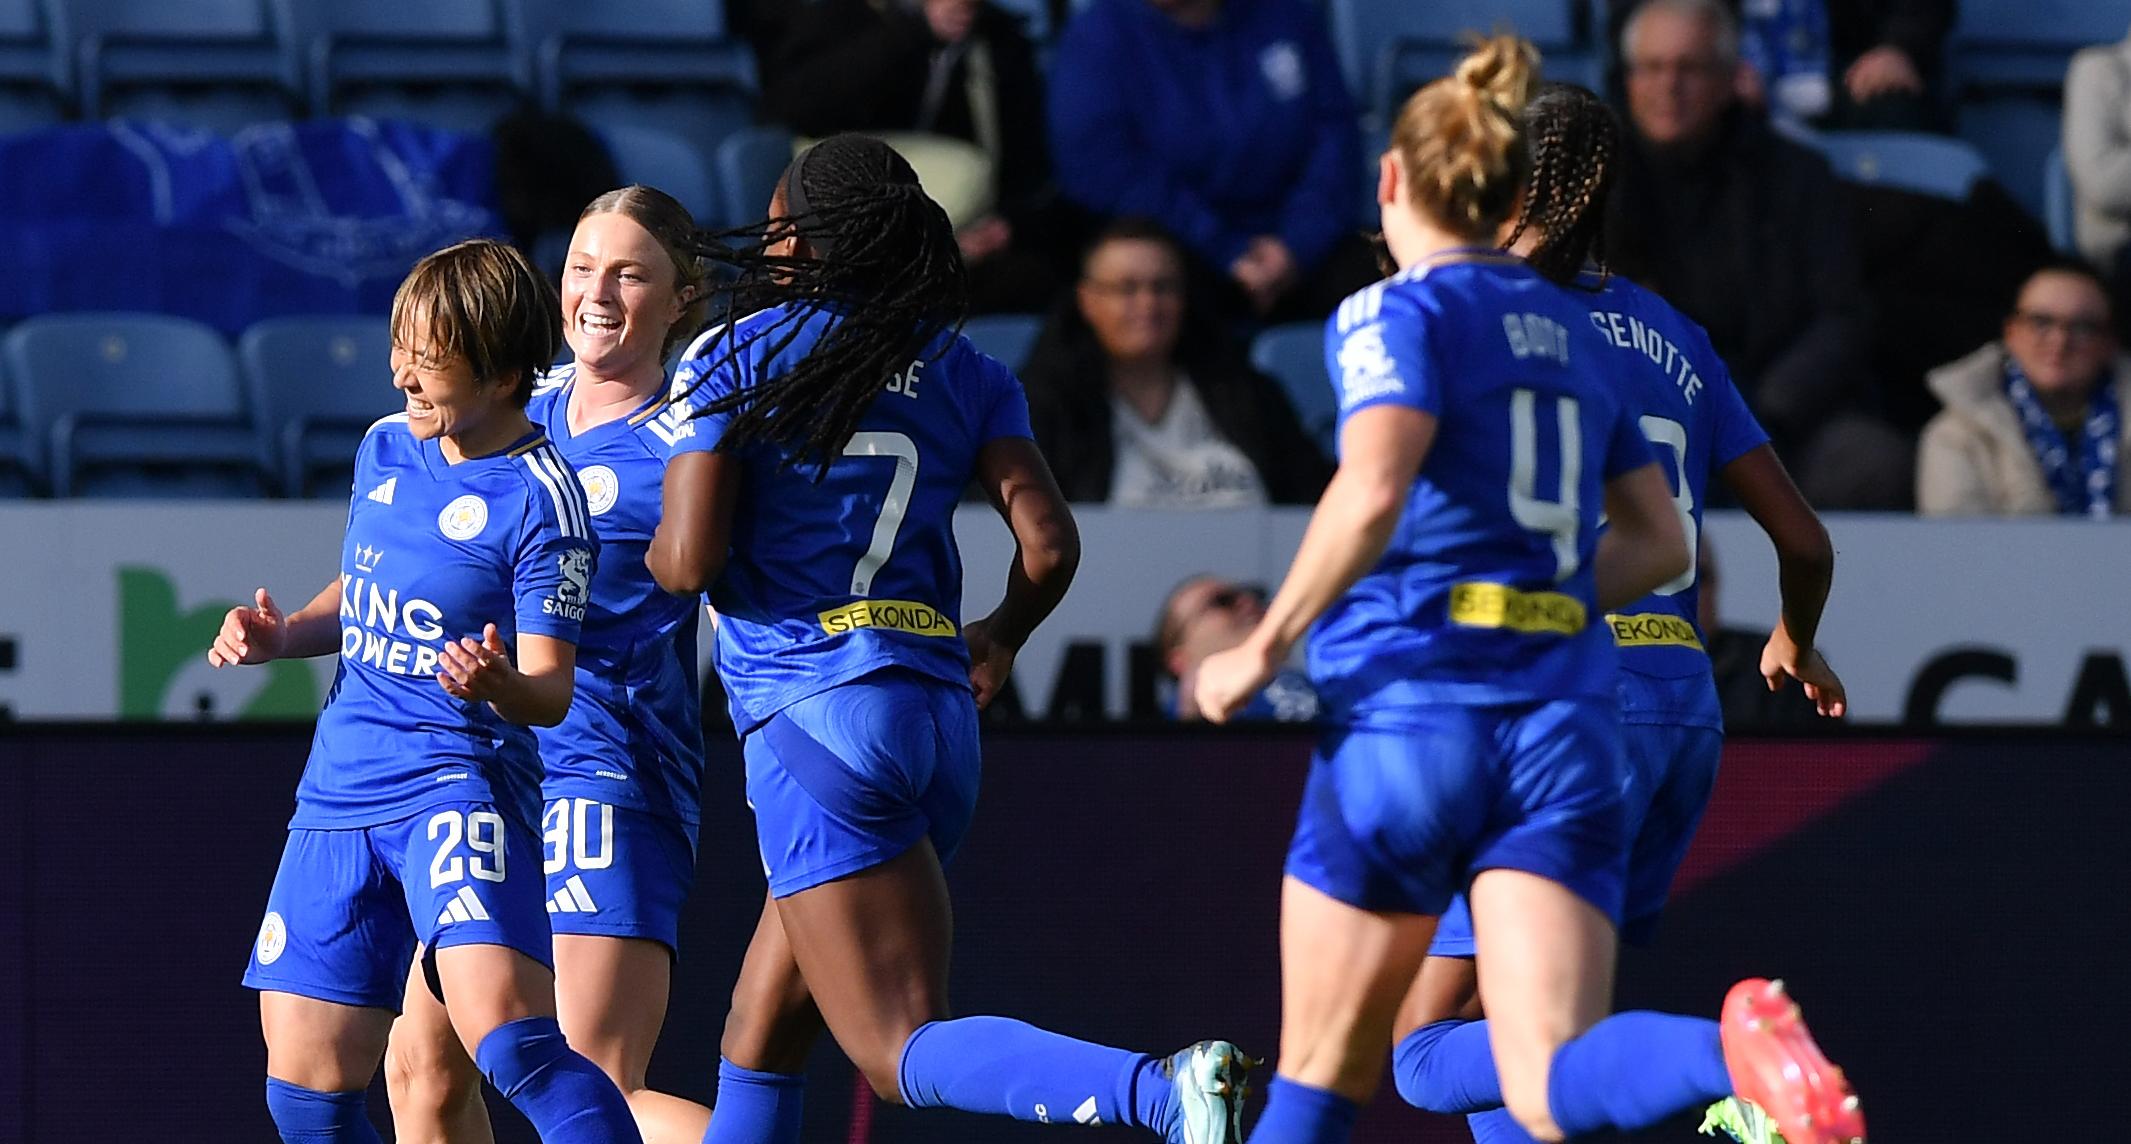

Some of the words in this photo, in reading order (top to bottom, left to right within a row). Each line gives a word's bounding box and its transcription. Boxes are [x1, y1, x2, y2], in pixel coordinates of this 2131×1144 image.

[843, 432, 918, 597] 7
[1508, 387, 1581, 582] 4
[1597, 414, 1698, 596] 3
[340, 571, 443, 640] KING
[542, 598, 585, 622] SAIGO
[828, 605, 950, 634] SEKONDA
[341, 626, 437, 676] OWER
[427, 810, 505, 889] 29
[542, 798, 613, 875] 30
